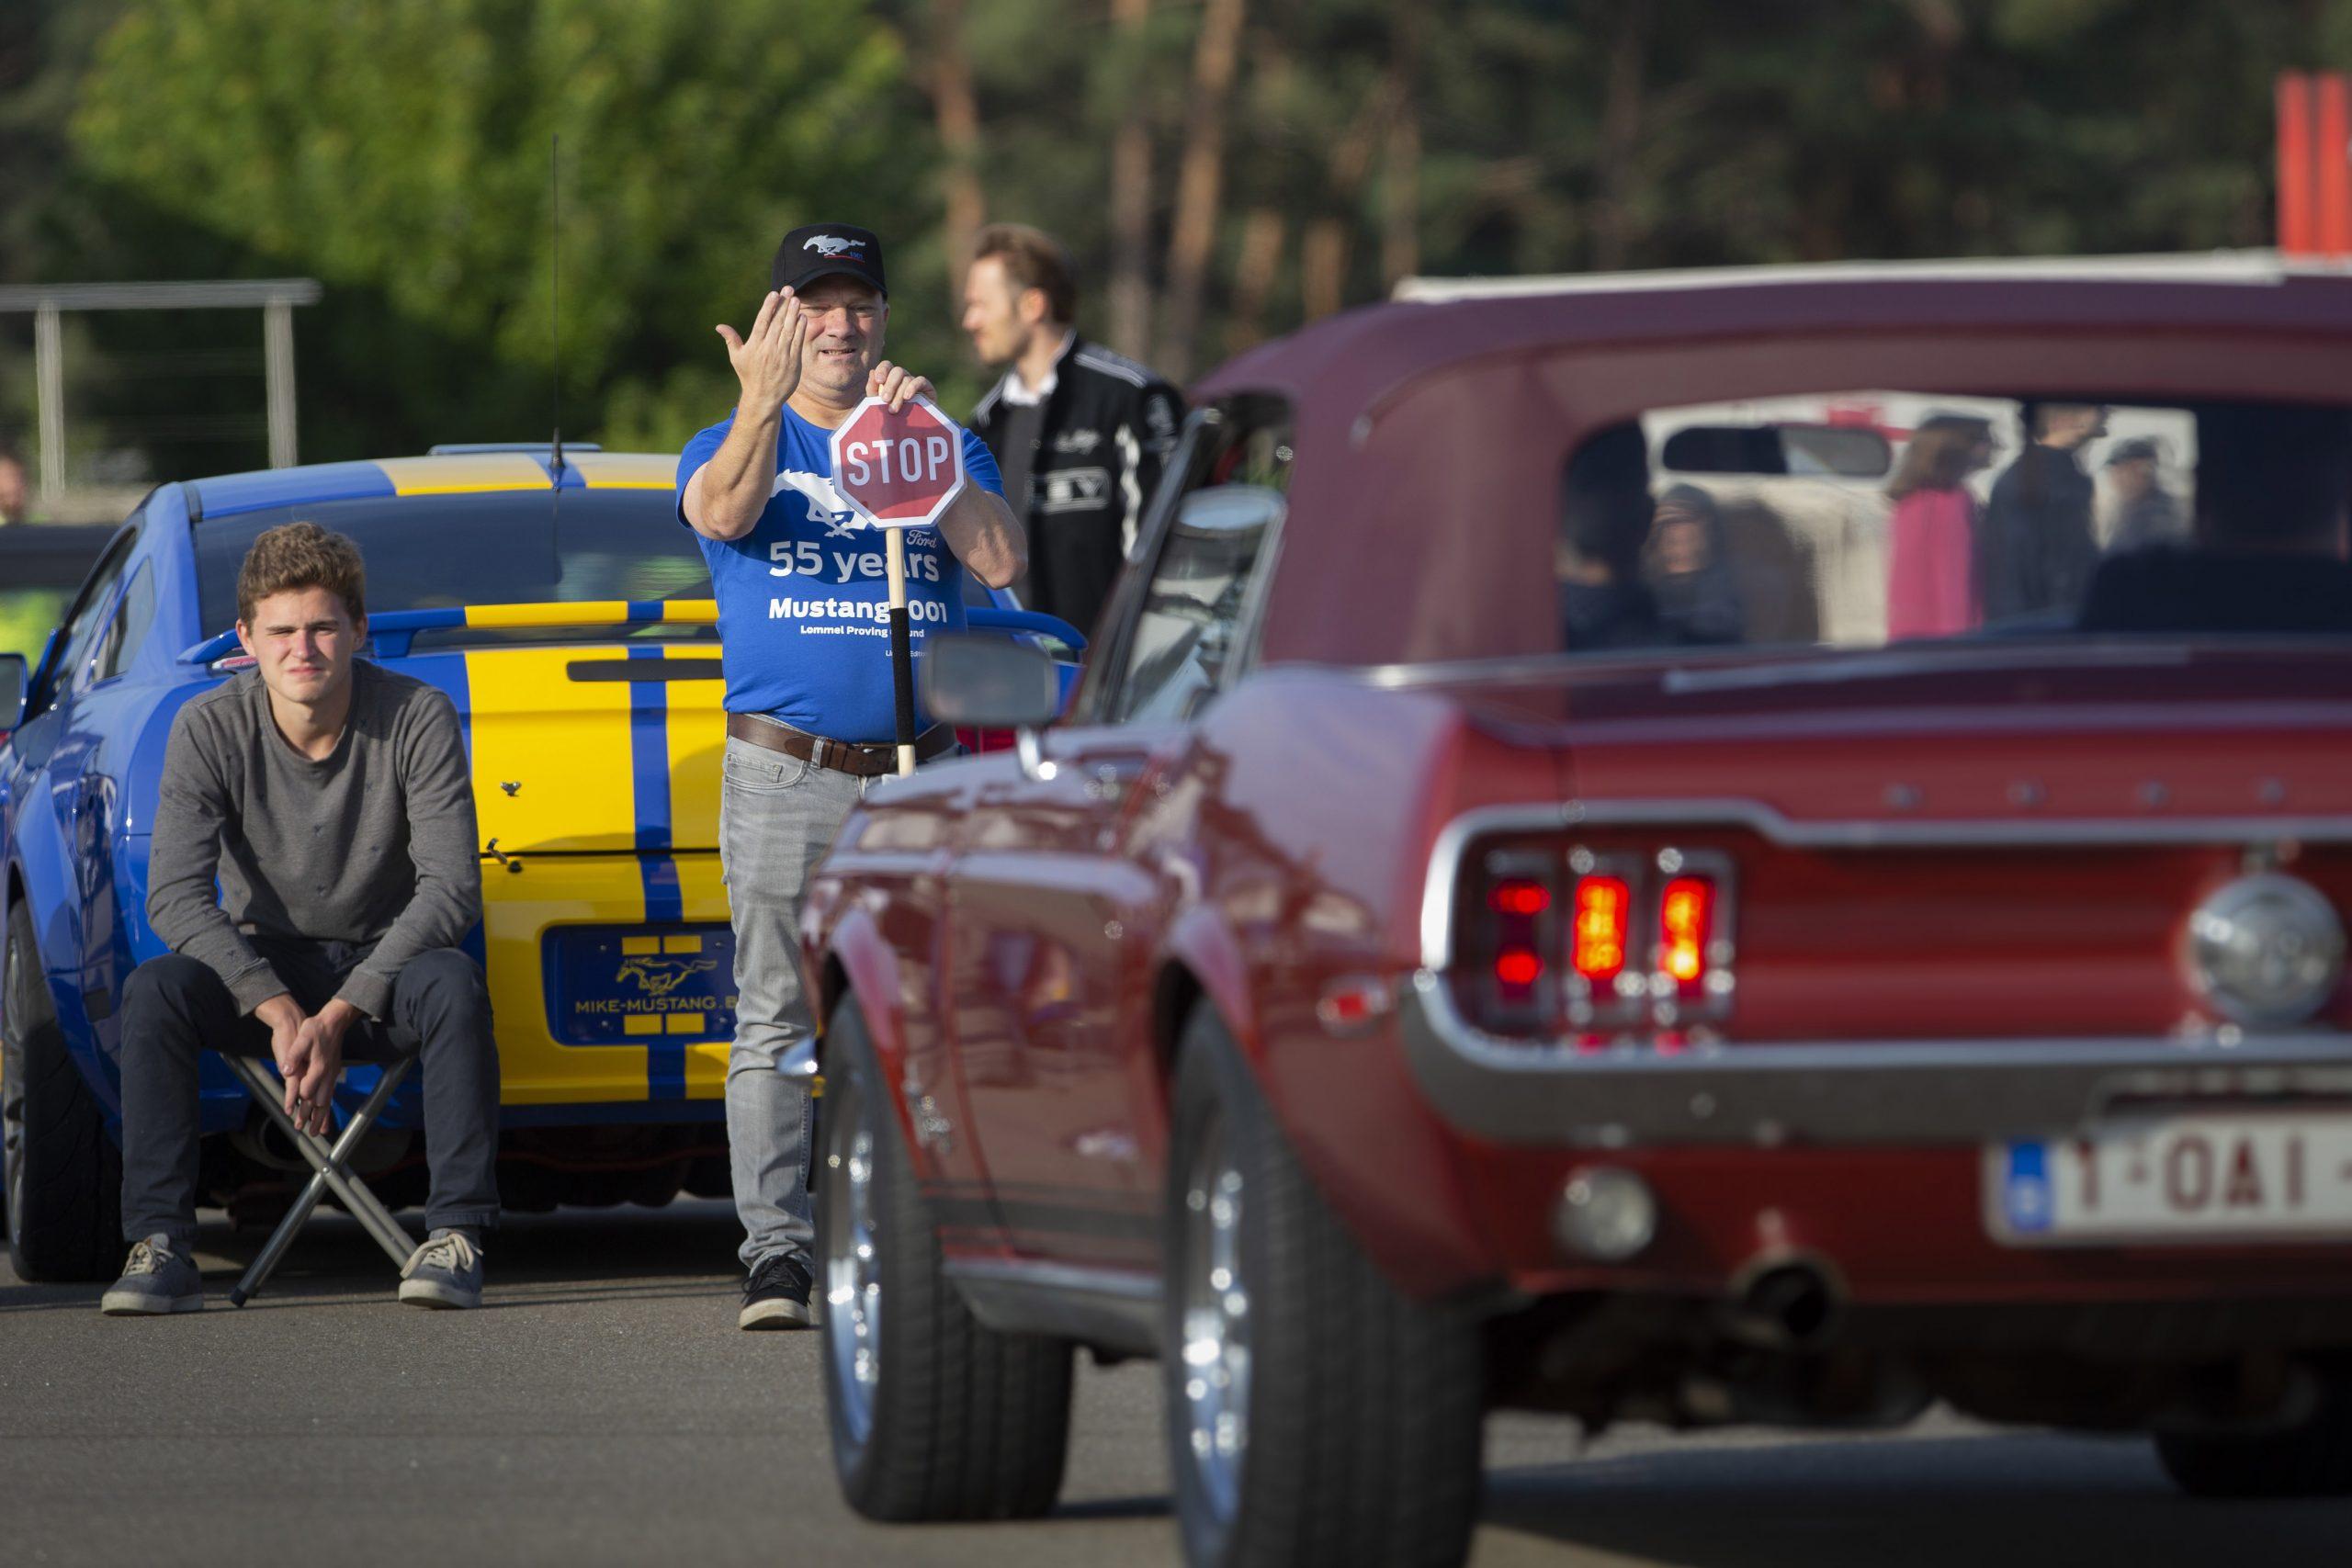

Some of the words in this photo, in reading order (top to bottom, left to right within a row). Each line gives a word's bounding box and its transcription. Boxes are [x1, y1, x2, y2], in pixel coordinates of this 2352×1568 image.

[846, 435, 949, 486] STOP
[906, 529, 937, 548] Ford
[769, 541, 823, 577] 55
[768, 598, 891, 624] Mustang
[907, 599, 948, 623] 001
[800, 626, 844, 636] Lommel
[846, 626, 888, 638] Proving
